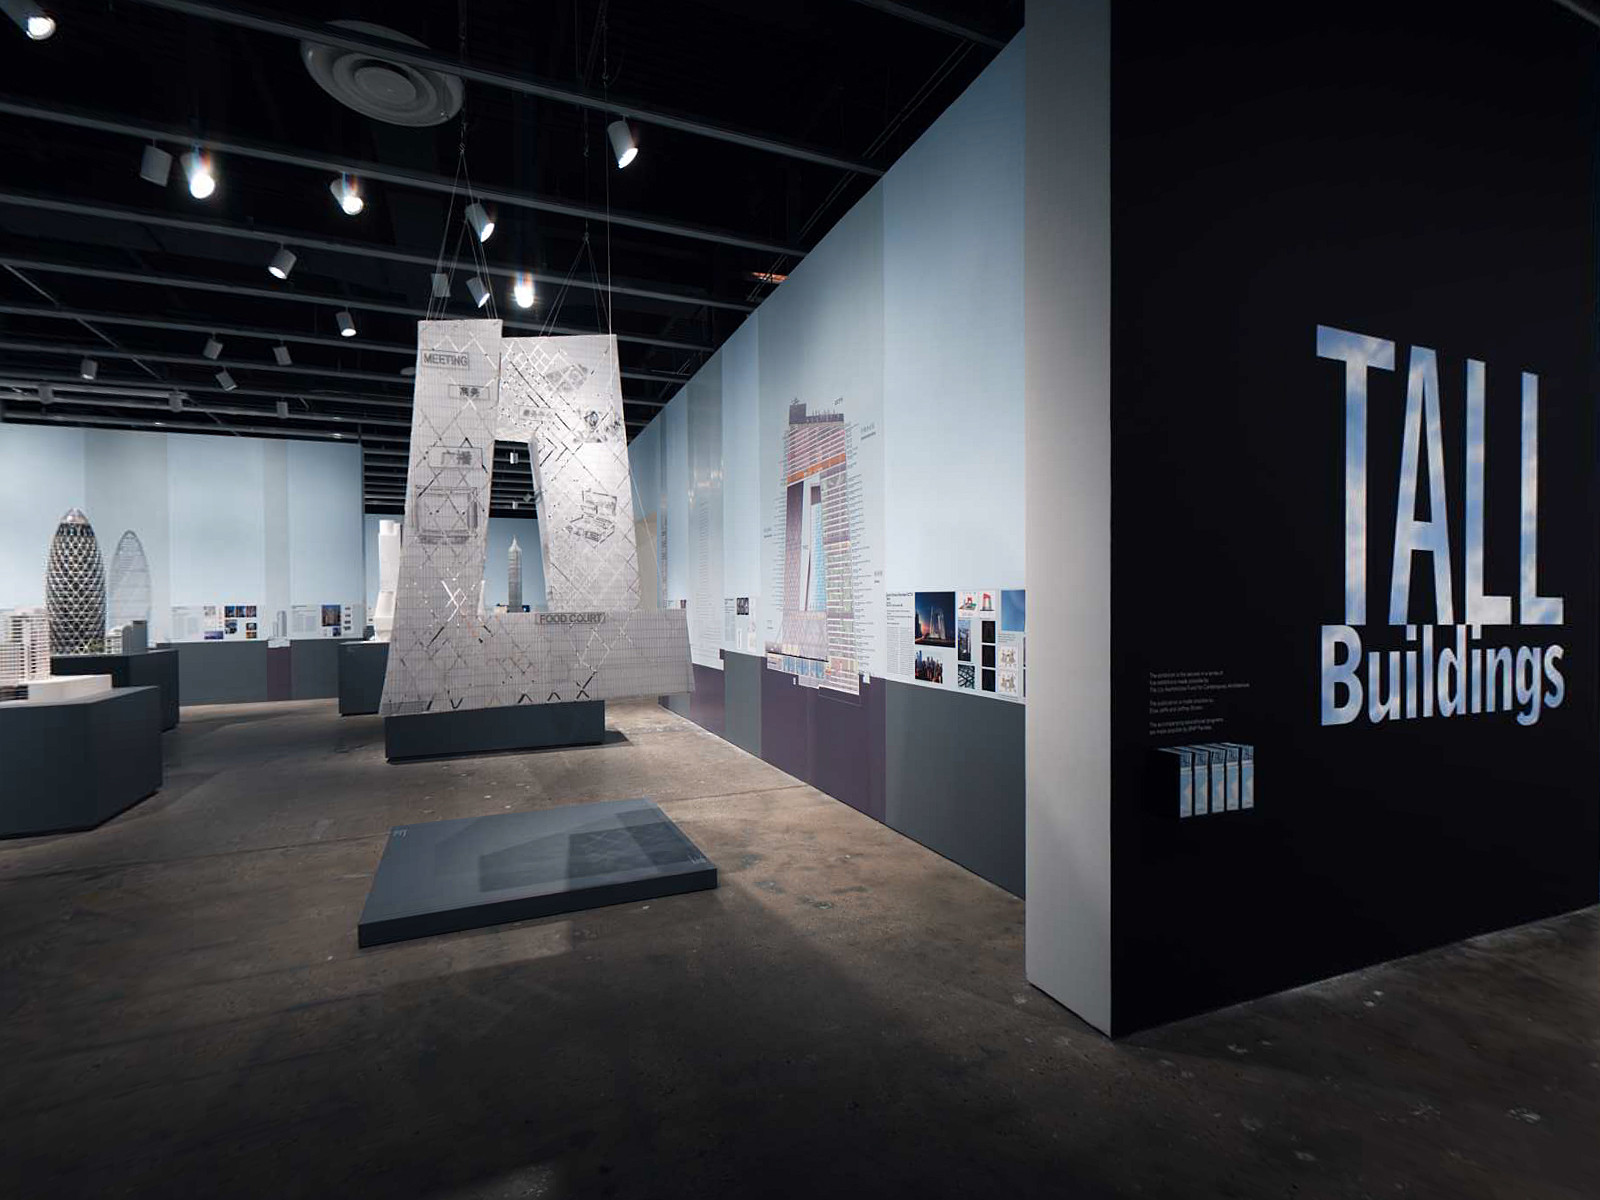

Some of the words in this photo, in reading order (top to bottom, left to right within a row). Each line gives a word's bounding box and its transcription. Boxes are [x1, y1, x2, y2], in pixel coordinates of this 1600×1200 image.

[423, 352, 468, 367] MEETING
[1316, 324, 1565, 626] TALL
[540, 613, 567, 624] FOOD
[569, 612, 603, 623] COURT
[1321, 624, 1566, 727] Buildings
